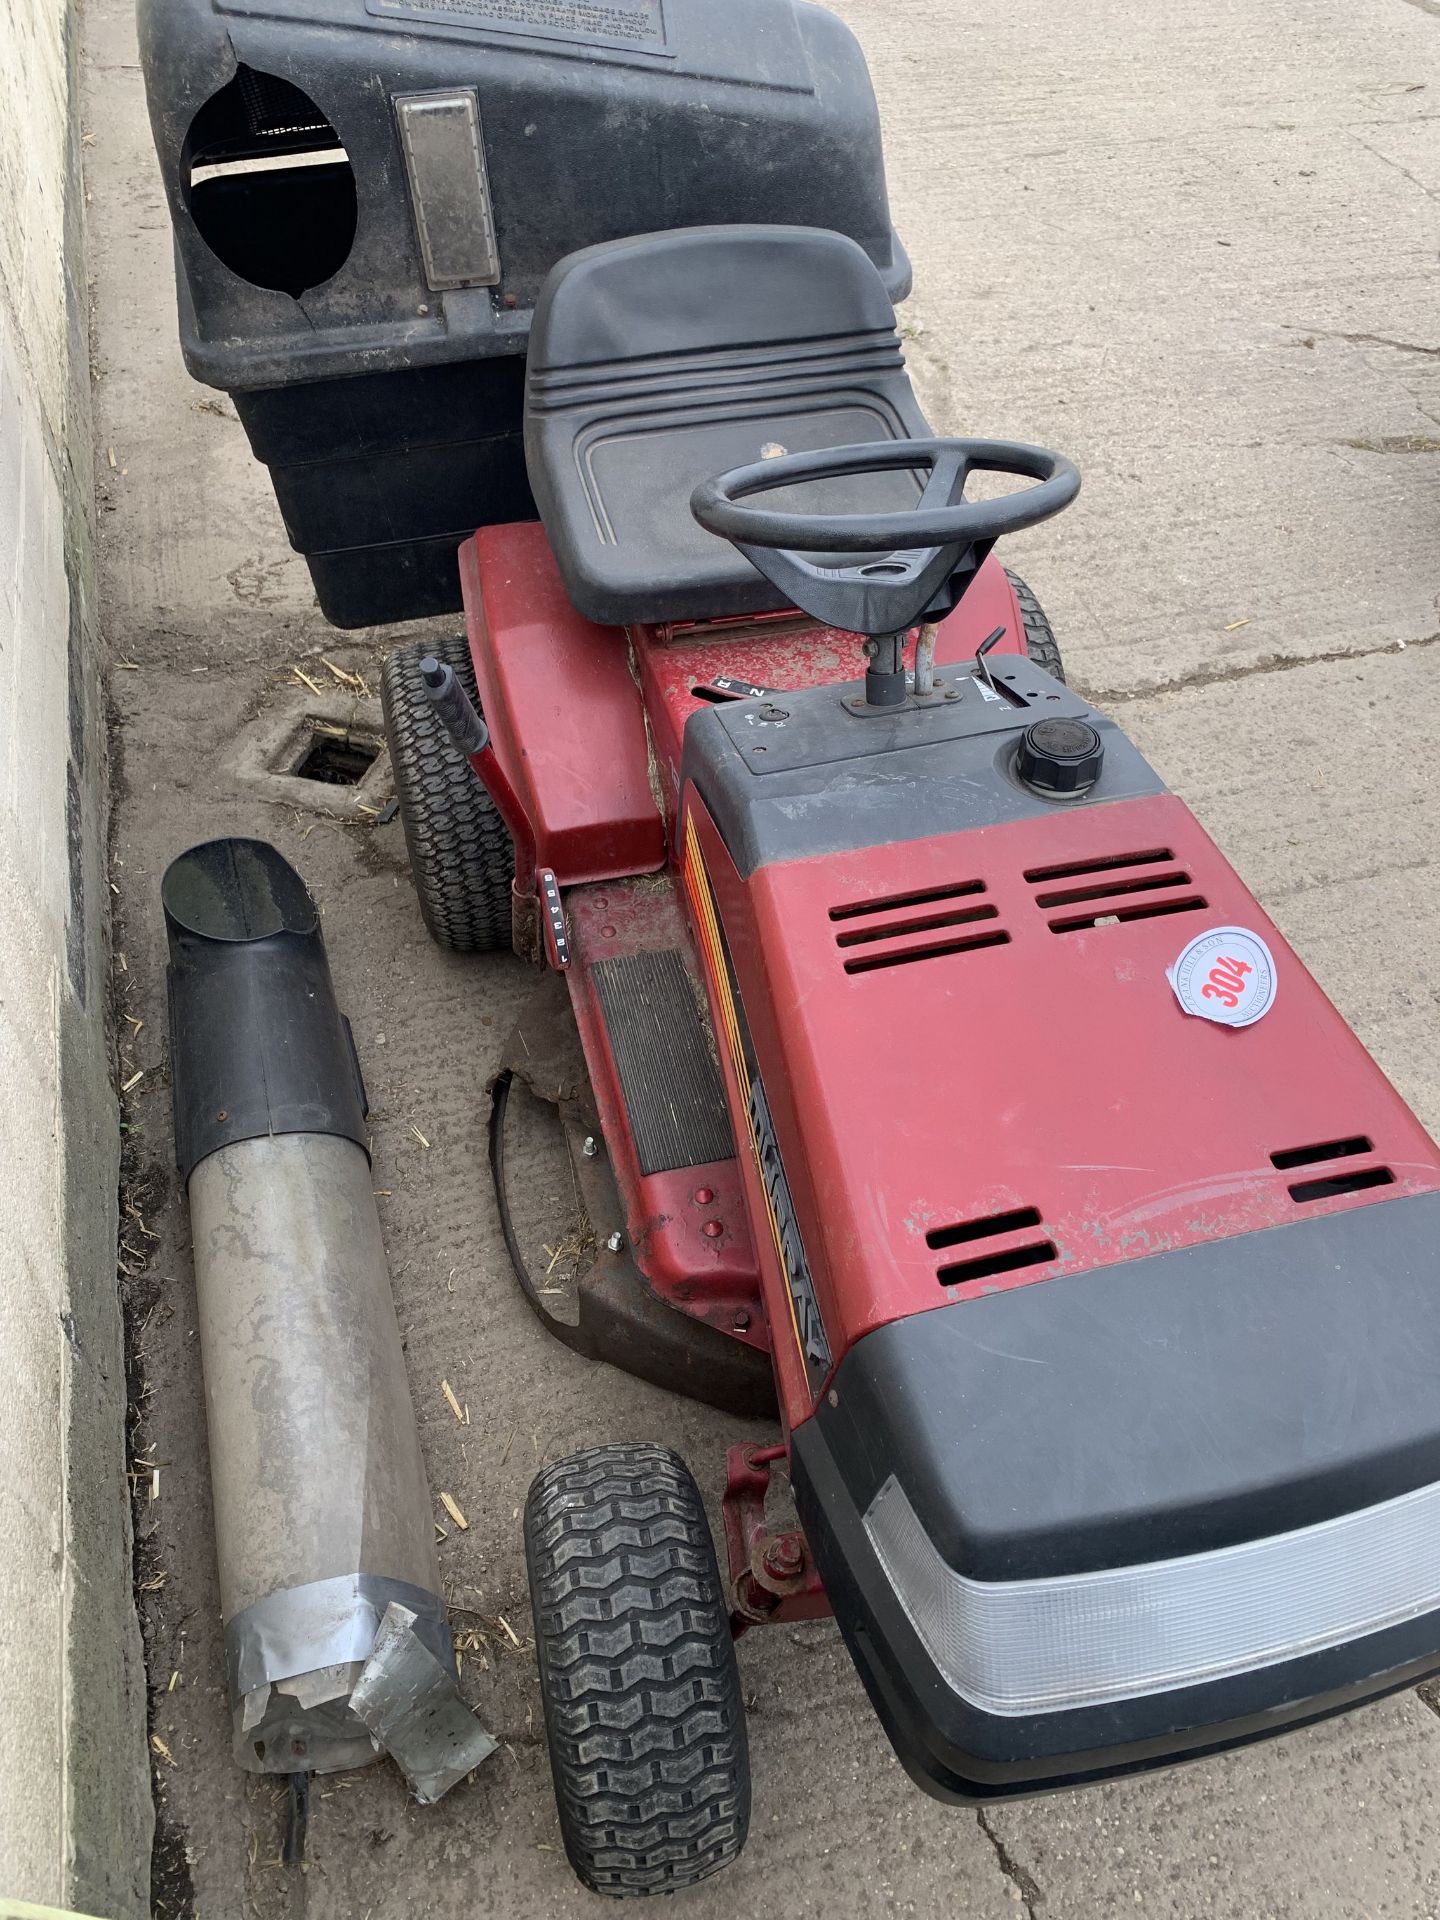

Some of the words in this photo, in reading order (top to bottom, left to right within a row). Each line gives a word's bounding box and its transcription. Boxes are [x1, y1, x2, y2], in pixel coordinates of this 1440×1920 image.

[717, 679, 731, 689] R
[749, 687, 765, 697] N
[550, 906, 560, 914] 4
[553, 921, 562, 930] 3
[561, 955, 568, 963] 1
[1182, 954, 1199, 974] HILL
[1202, 936, 1224, 950] SON
[1201, 955, 1253, 1008] 304
[1241, 968, 1268, 1018] AUCTIONEERS
